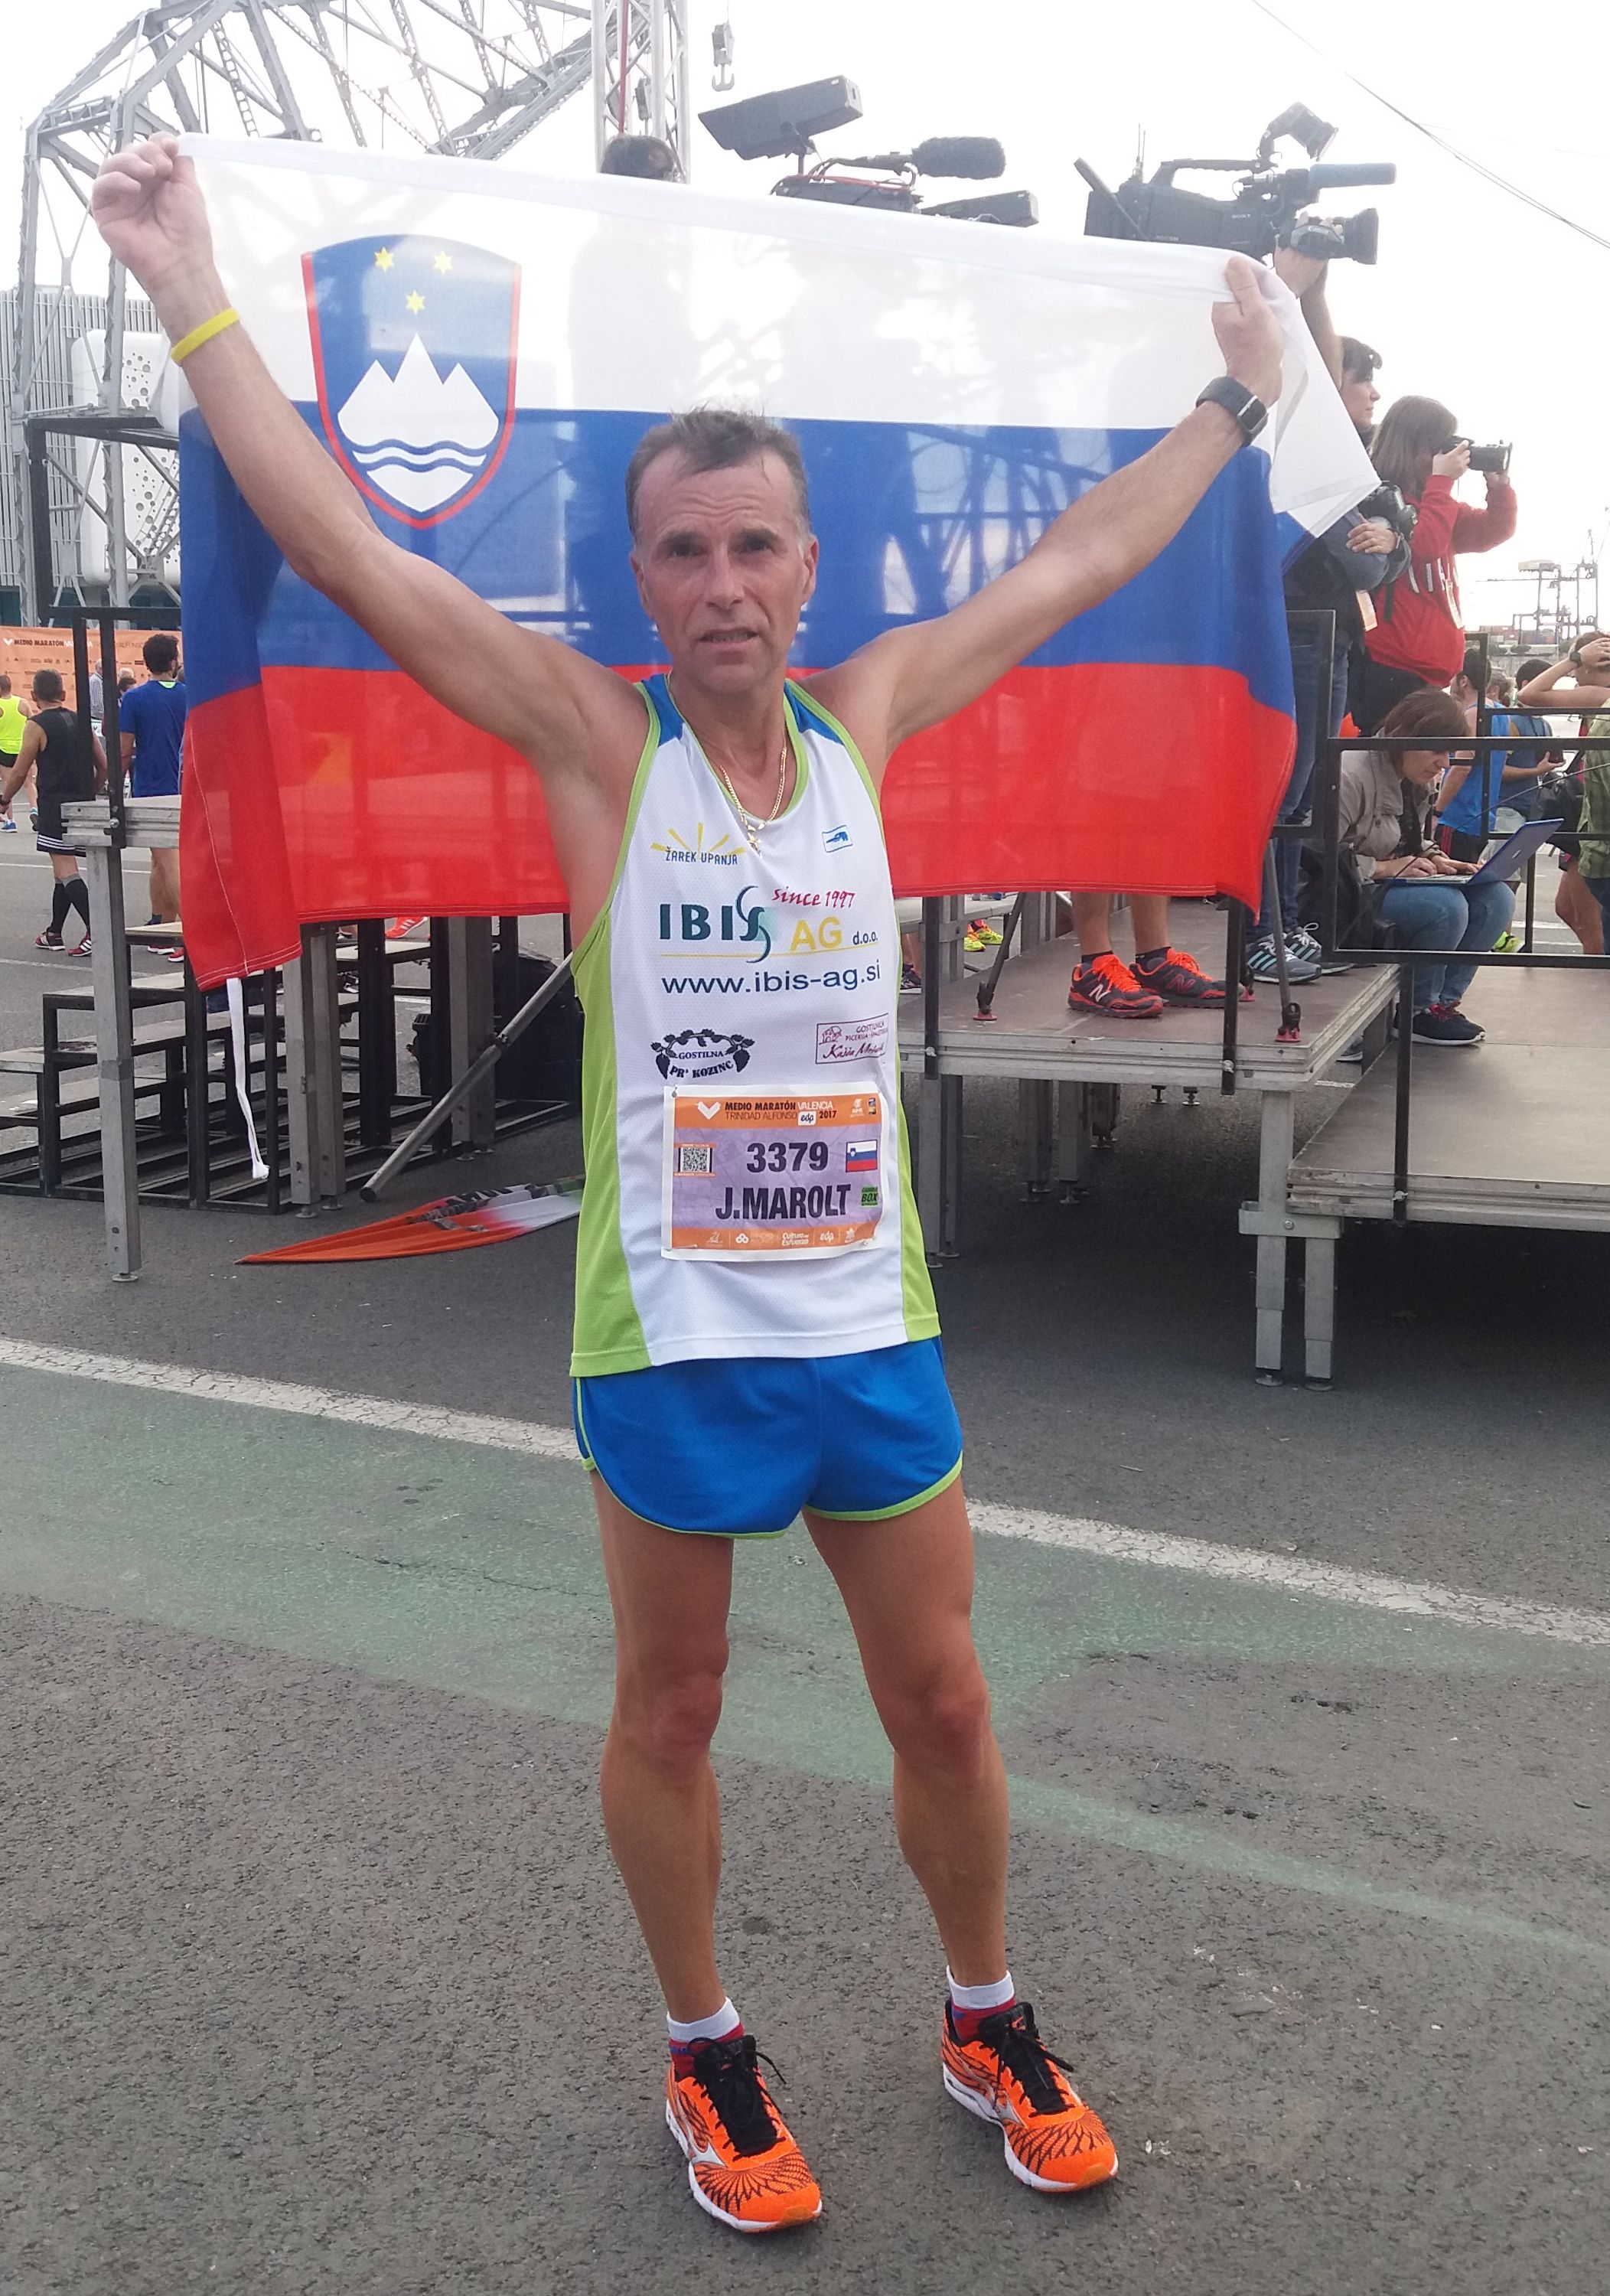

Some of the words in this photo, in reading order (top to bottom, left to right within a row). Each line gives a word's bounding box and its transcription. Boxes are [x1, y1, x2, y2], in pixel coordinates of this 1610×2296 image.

[665, 846, 697, 863] ŽAREK
[701, 852, 738, 866] UPANJA
[772, 885, 822, 906] since
[825, 890, 856, 908] 1997
[660, 885, 771, 963] IBIS
[789, 916, 842, 951] AG
[852, 931, 878, 945] d.o.o.
[662, 959, 881, 993] www.ibis-ag.si
[679, 1051, 724, 1059] GOSTILNA
[693, 1061, 734, 1078] KOZINC
[725, 1102, 751, 1111] MEDIO
[754, 1101, 796, 1110] MARATÓN
[797, 1101, 833, 1110] VALENCIA
[819, 1110, 837, 1119] 2017
[725, 1111, 761, 1120] TRINIDAD
[763, 1111, 797, 1120] ALFONSO
[800, 1113, 814, 1124] edp
[746, 1141, 829, 1173] 3379
[715, 1184, 851, 1219] J.MAROLT
[861, 1192, 878, 1202] BOX
